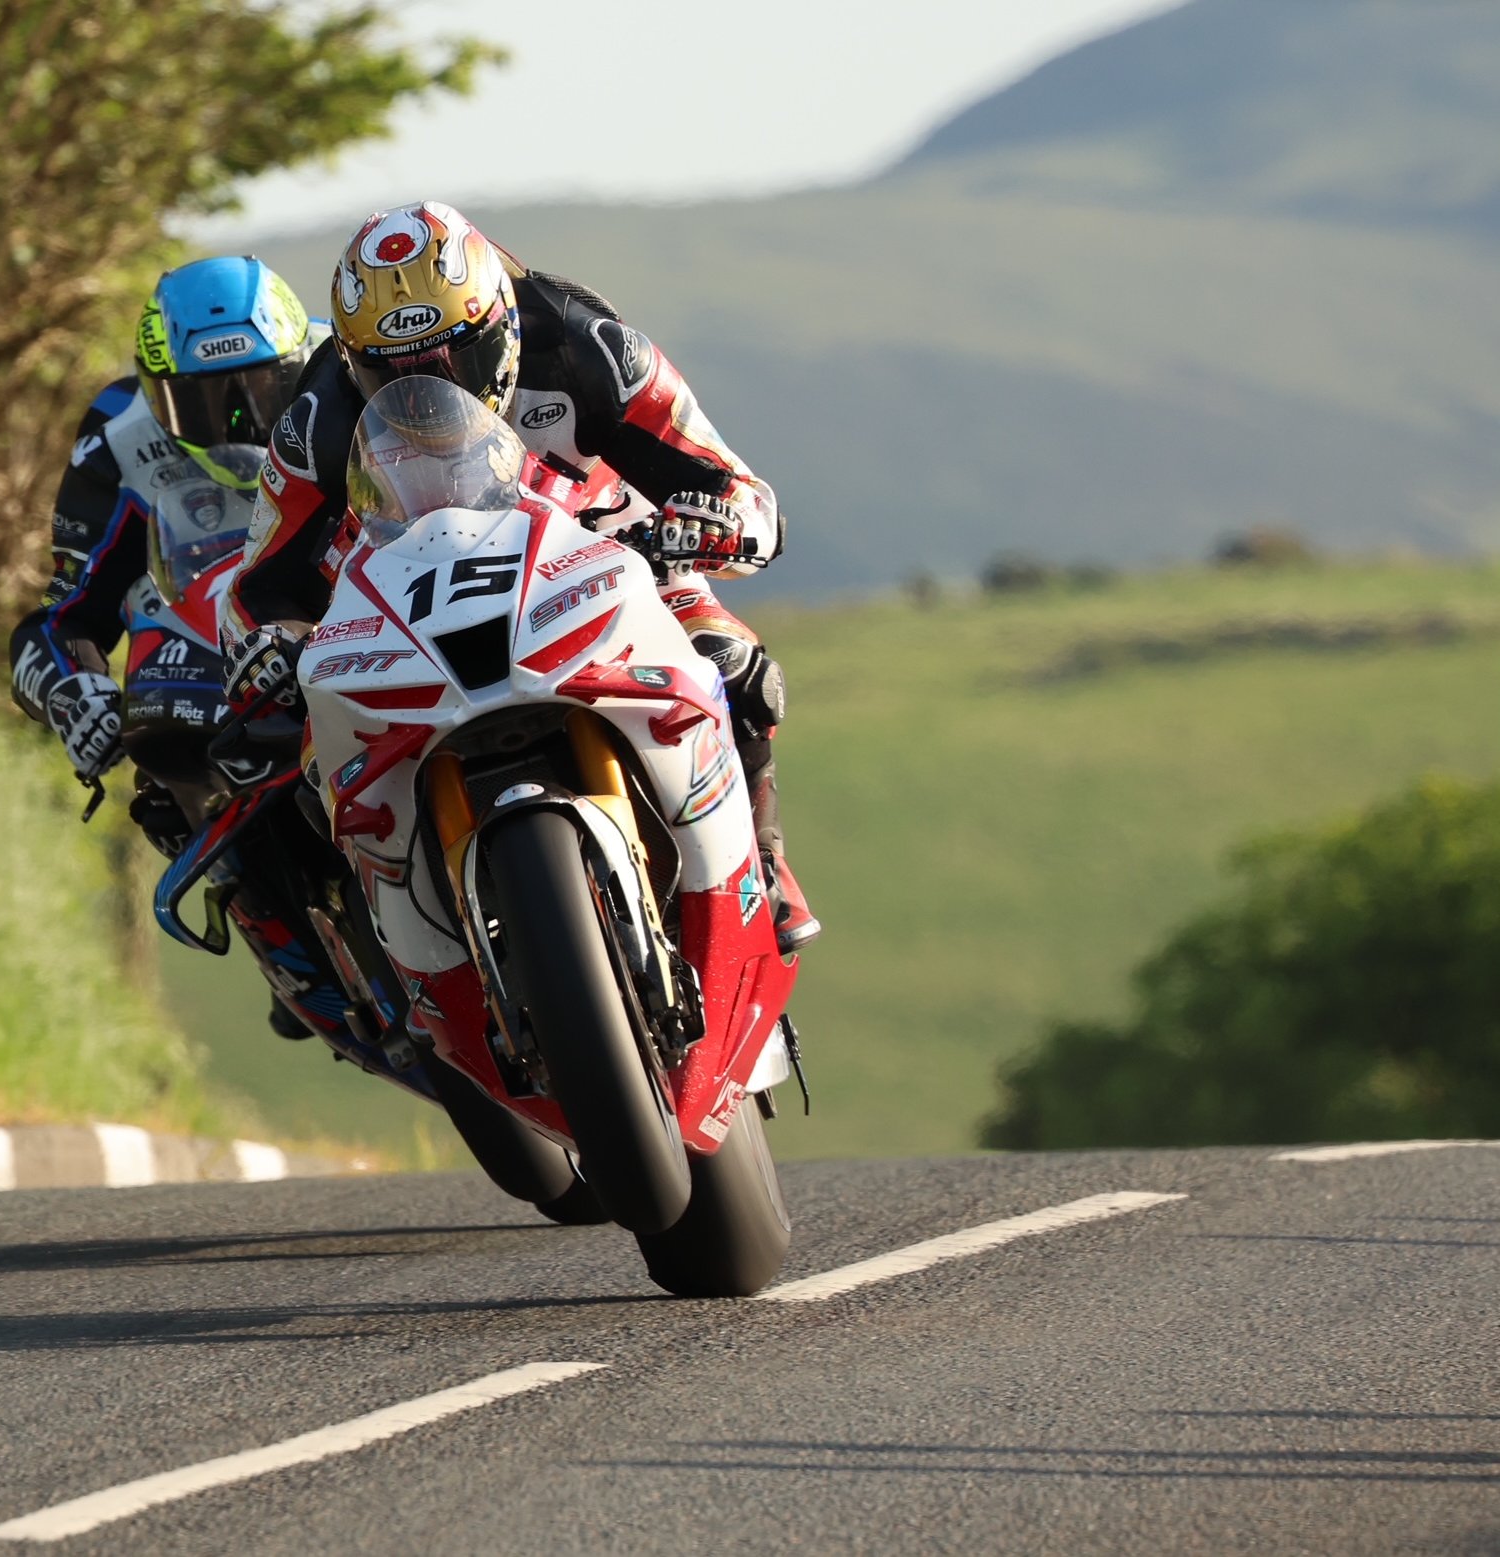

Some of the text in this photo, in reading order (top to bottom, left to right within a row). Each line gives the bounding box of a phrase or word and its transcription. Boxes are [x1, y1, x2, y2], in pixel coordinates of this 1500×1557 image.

[383, 307, 433, 334] Arai
[201, 337, 246, 359] SHOEI
[380, 341, 421, 355] GRANITE
[424, 330, 451, 347] MOTO
[529, 403, 563, 424] Arai
[537, 551, 587, 574] VRS
[404, 553, 522, 626] 15
[530, 565, 624, 633] SMT
[313, 621, 352, 640] VRS
[308, 650, 417, 684] SMT
[173, 705, 204, 719] Plötz
